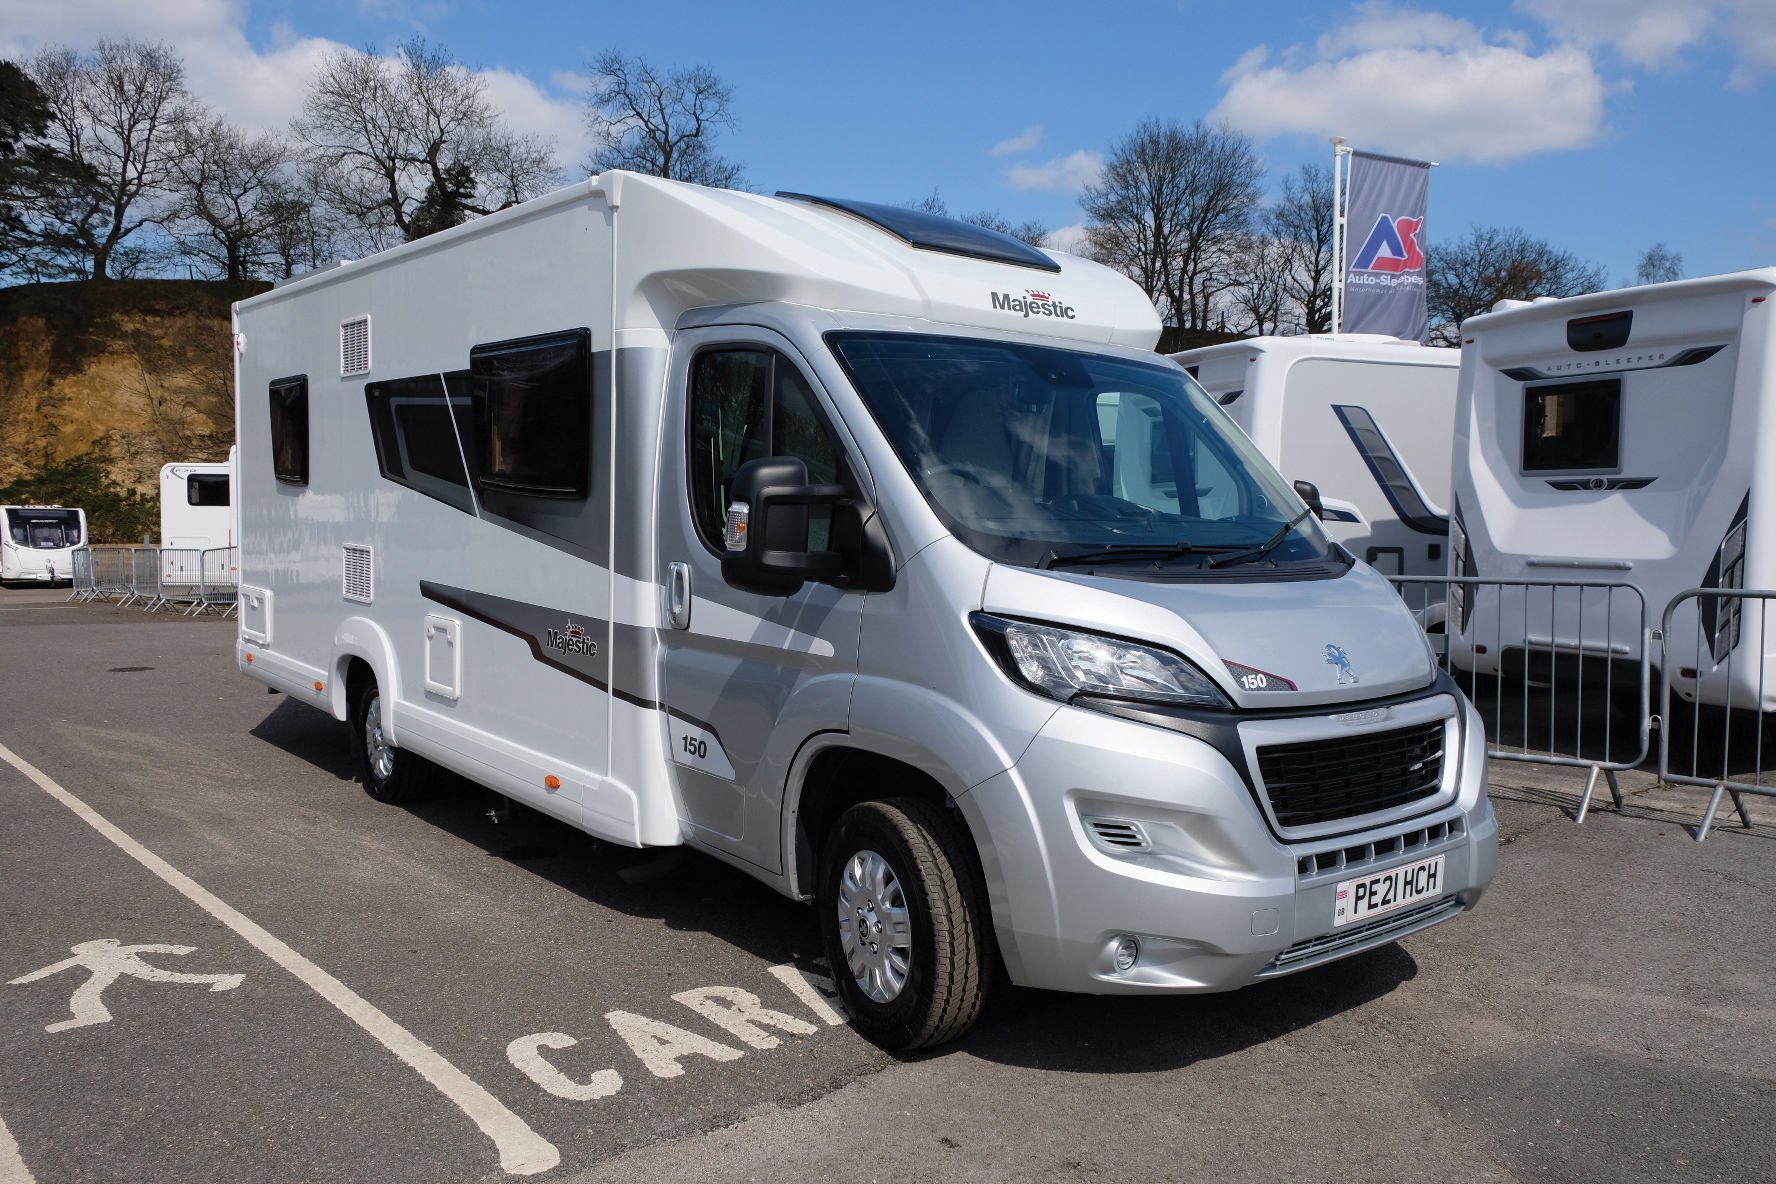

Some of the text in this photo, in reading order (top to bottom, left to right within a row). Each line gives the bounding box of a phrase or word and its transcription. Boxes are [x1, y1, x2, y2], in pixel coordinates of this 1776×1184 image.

[1347, 273, 1424, 286] Auto-Sleepes
[990, 291, 1076, 320] Majestic
[1546, 353, 1665, 372] AUTO-SLEEPER
[547, 628, 597, 657] Majestic
[1241, 674, 1267, 689] 150
[682, 734, 707, 759] 150
[1402, 860, 1438, 900] HCH
